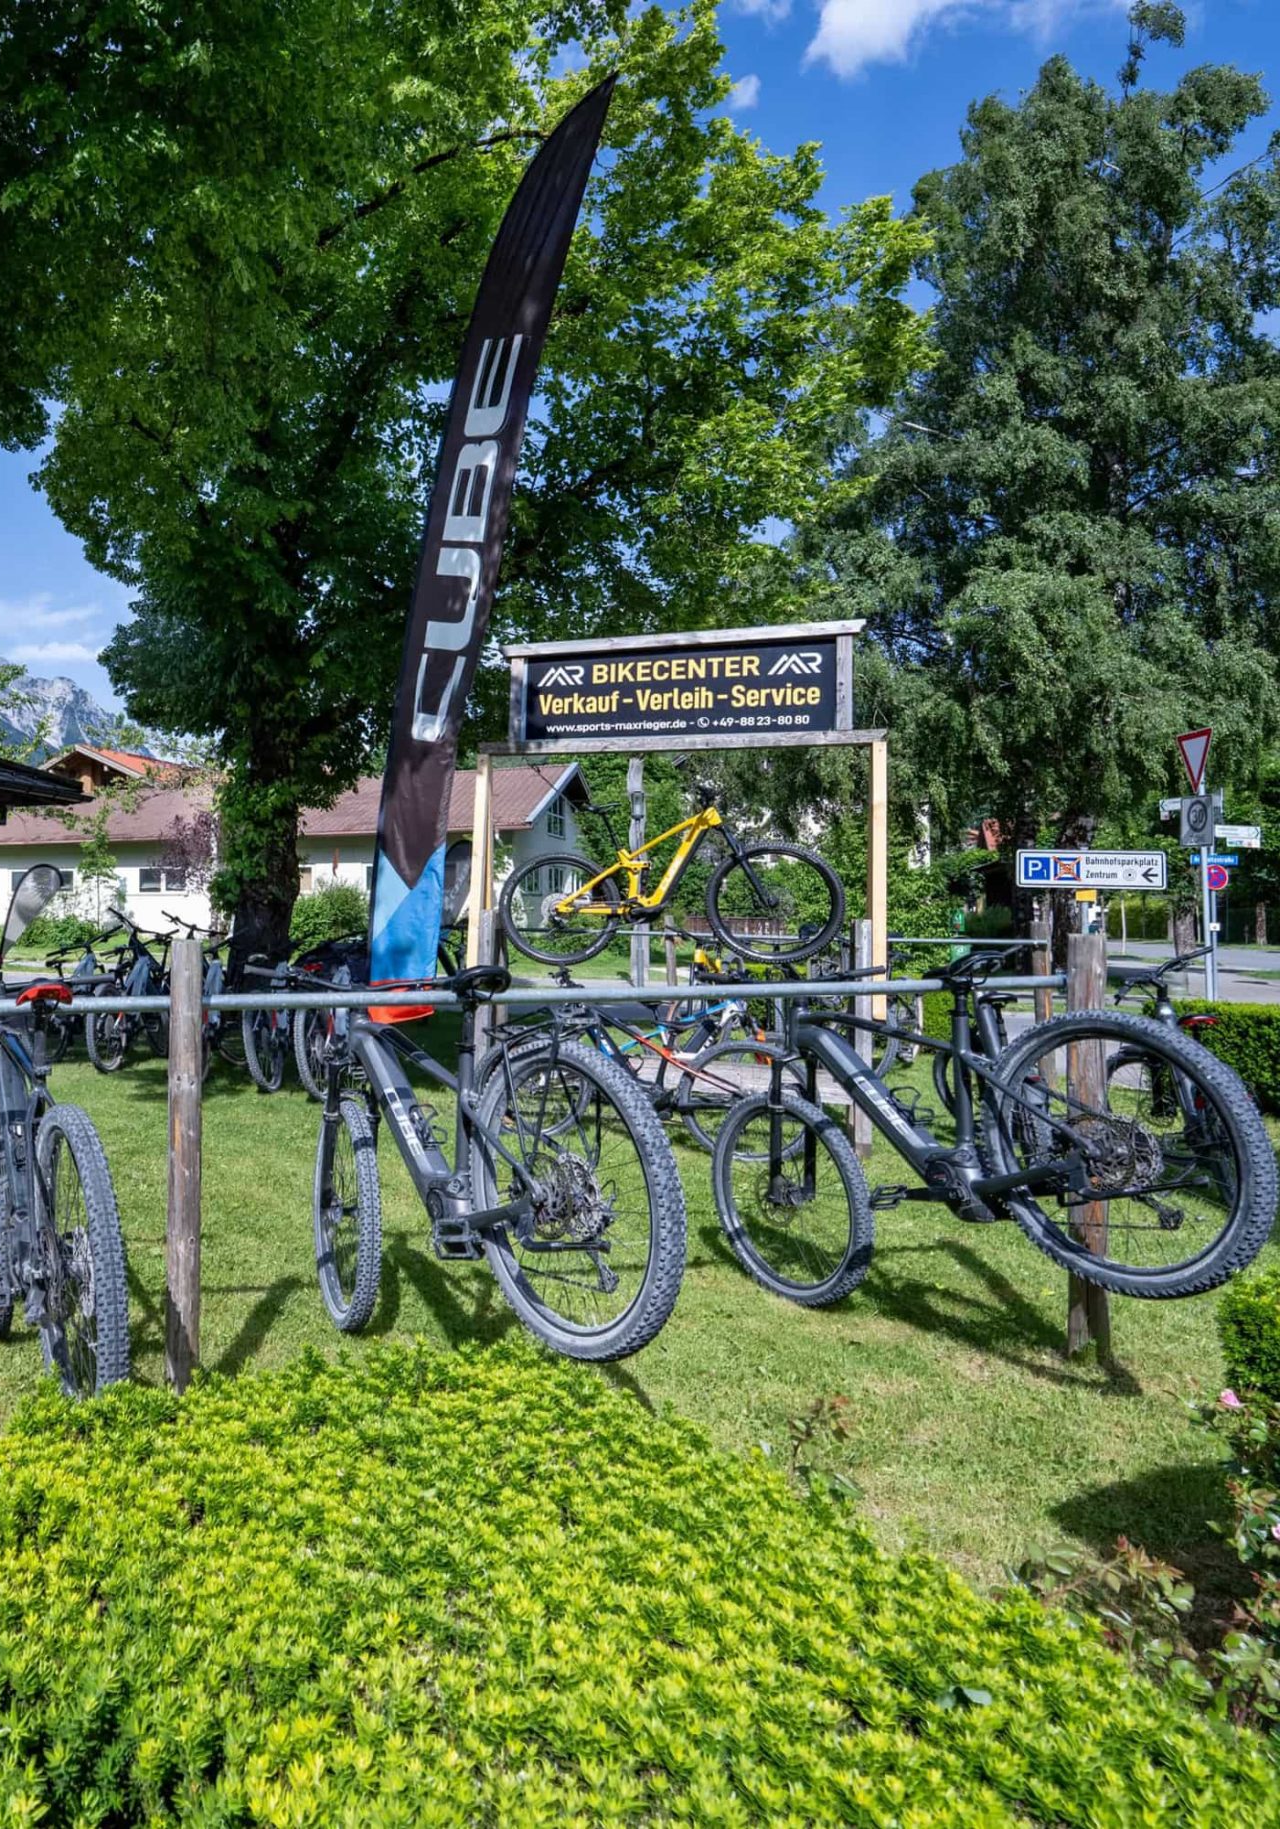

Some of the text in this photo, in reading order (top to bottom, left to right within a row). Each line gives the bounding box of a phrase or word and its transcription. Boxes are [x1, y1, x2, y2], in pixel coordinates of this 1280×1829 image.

[410, 333, 524, 742] CUBE
[591, 655, 761, 685] BIKECENTER
[538, 690, 620, 716] Verkauf
[635, 686, 714, 712] Verleih
[730, 682, 821, 708] Service
[545, 719, 687, 733] www.sports-maxrieger.de
[1191, 808, 1206, 825] 30
[1085, 856, 1160, 867] Bahnhofsparkplatz
[1085, 870, 1119, 879] Zentrum
